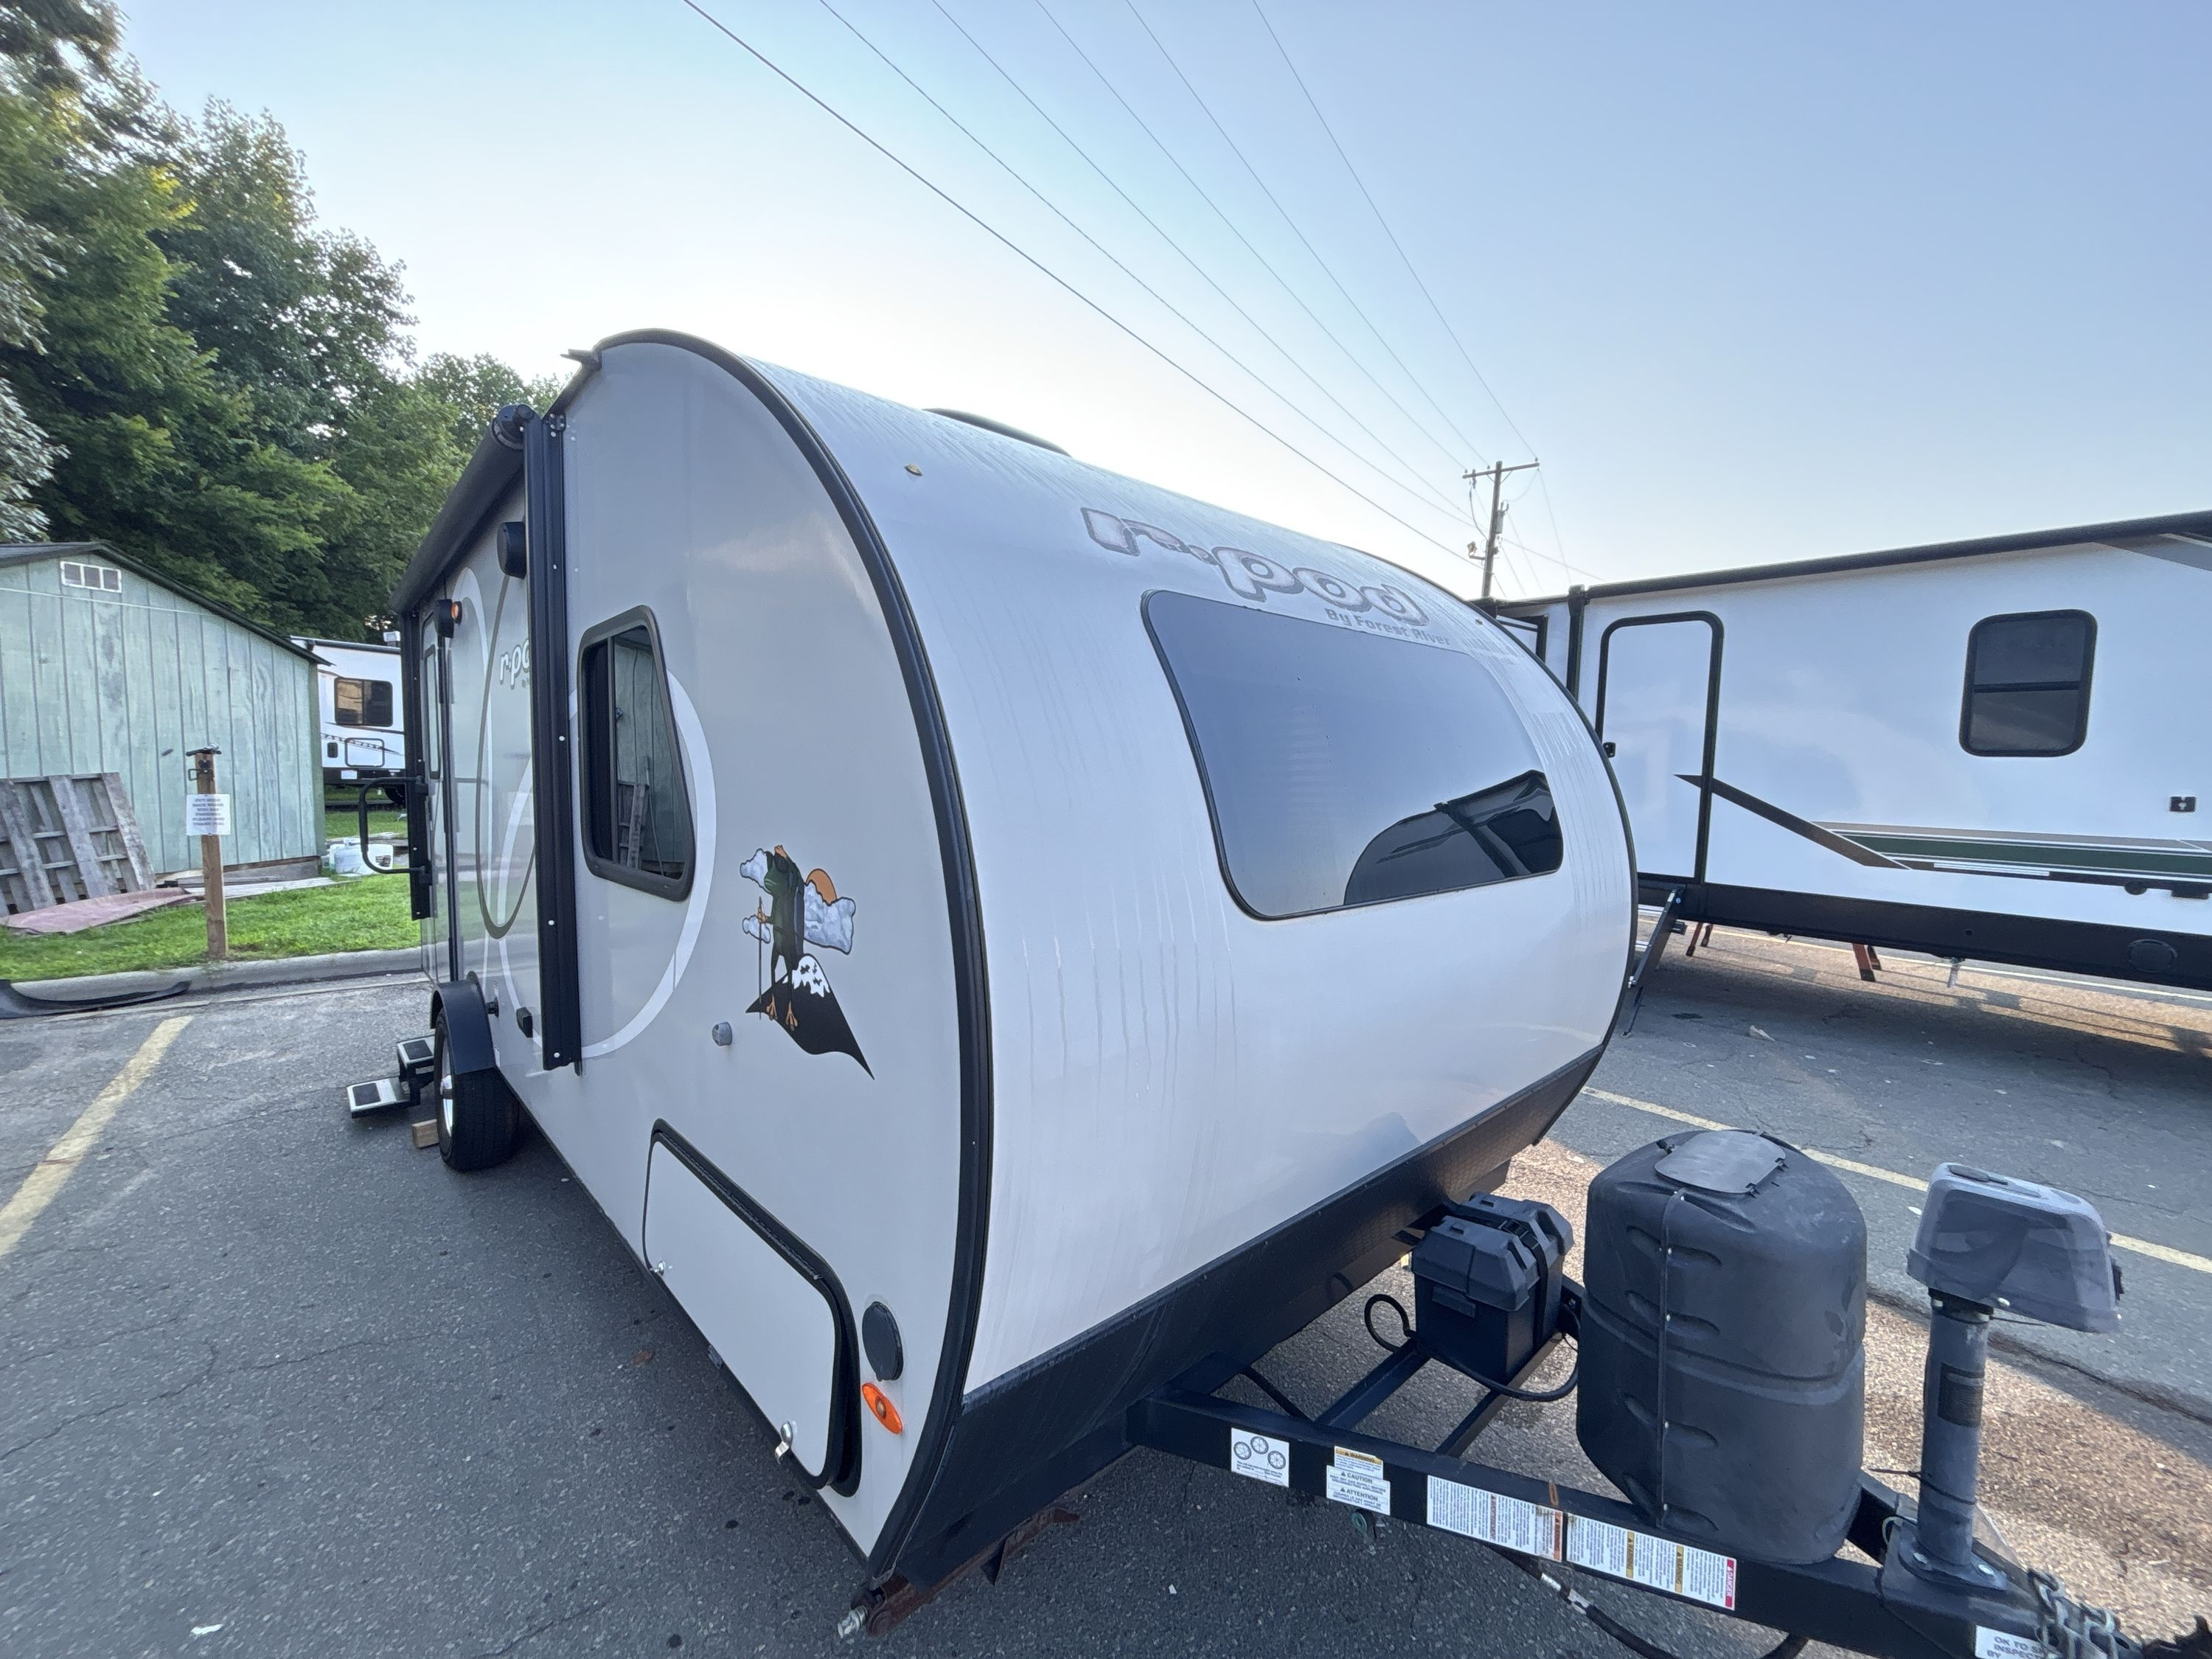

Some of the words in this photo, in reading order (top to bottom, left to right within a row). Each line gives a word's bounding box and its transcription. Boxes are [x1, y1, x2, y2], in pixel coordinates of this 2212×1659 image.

[1324, 608, 1352, 626] By
[1354, 615, 1408, 637] Forest
[1411, 629, 1450, 646] River
[500, 639, 531, 690] r-po
[1350, 1452, 1375, 1463] WARNING
[1347, 1472, 1373, 1484] CAUTION
[1346, 1489, 1378, 1501] ATTENTION
[1994, 1636, 2010, 1646] OK
[2014, 1641, 2028, 1650] TO
